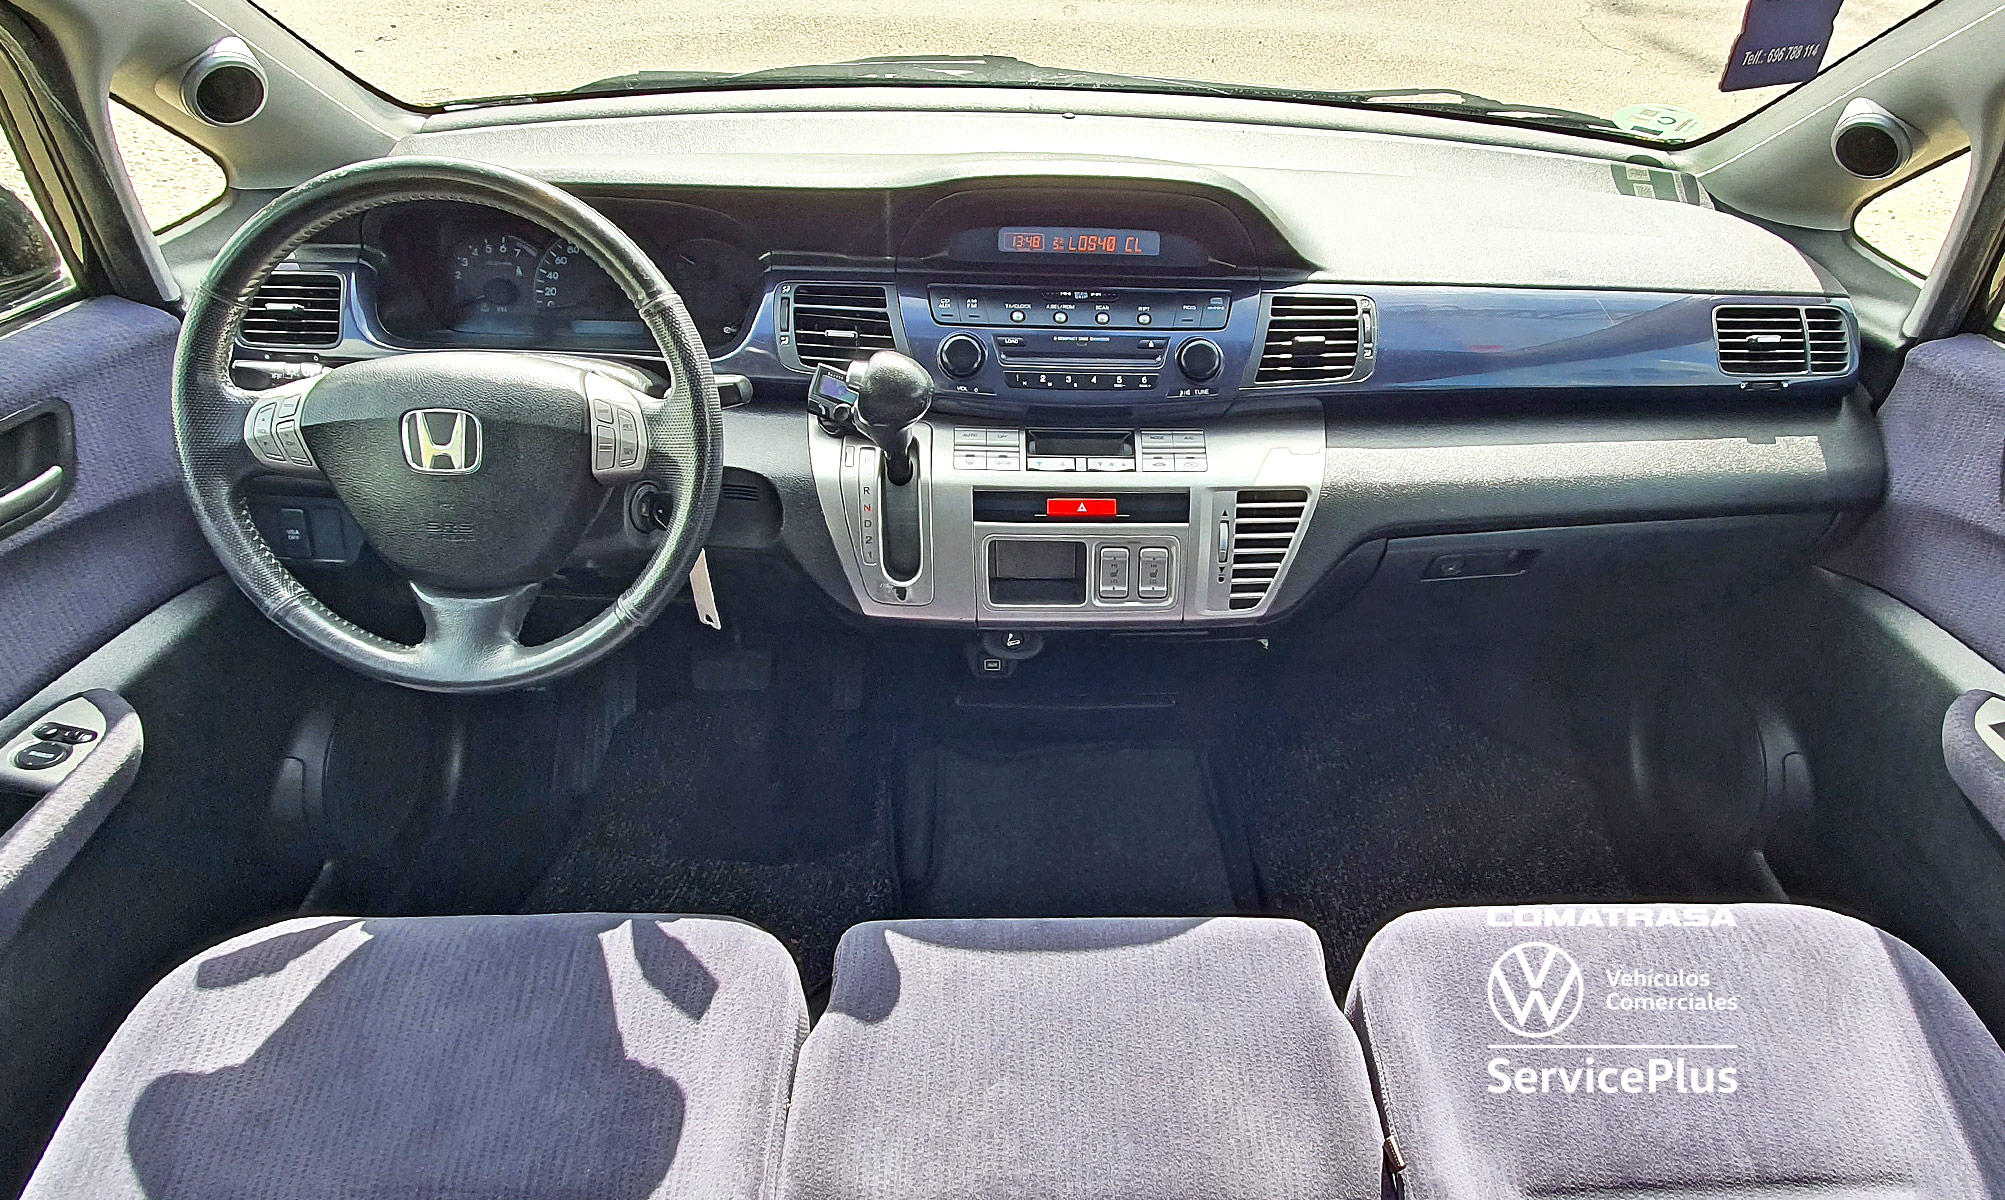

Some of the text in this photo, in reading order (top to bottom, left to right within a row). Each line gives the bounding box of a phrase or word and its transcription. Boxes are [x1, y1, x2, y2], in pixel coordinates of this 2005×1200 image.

[1011, 233, 1042, 249] 13:48
[1124, 236, 1143, 253] CL
[485, 244, 492, 254] 5
[499, 243, 507, 253] 6
[515, 248, 521, 258] 7
[554, 255, 568, 265] 60
[545, 271, 560, 280] 40
[544, 286, 557, 297] 20
[1015, 373, 1019, 382] 1
[1039, 374, 1046, 383] 2
[1065, 375, 1072, 384] 3
[1090, 375, 1097, 384] 4
[1116, 375, 1123, 384] 5
[1141, 376, 1148, 384] 6
[863, 486, 871, 495] R
[863, 504, 872, 512] N
[864, 520, 872, 528] D
[865, 535, 873, 545] 2
